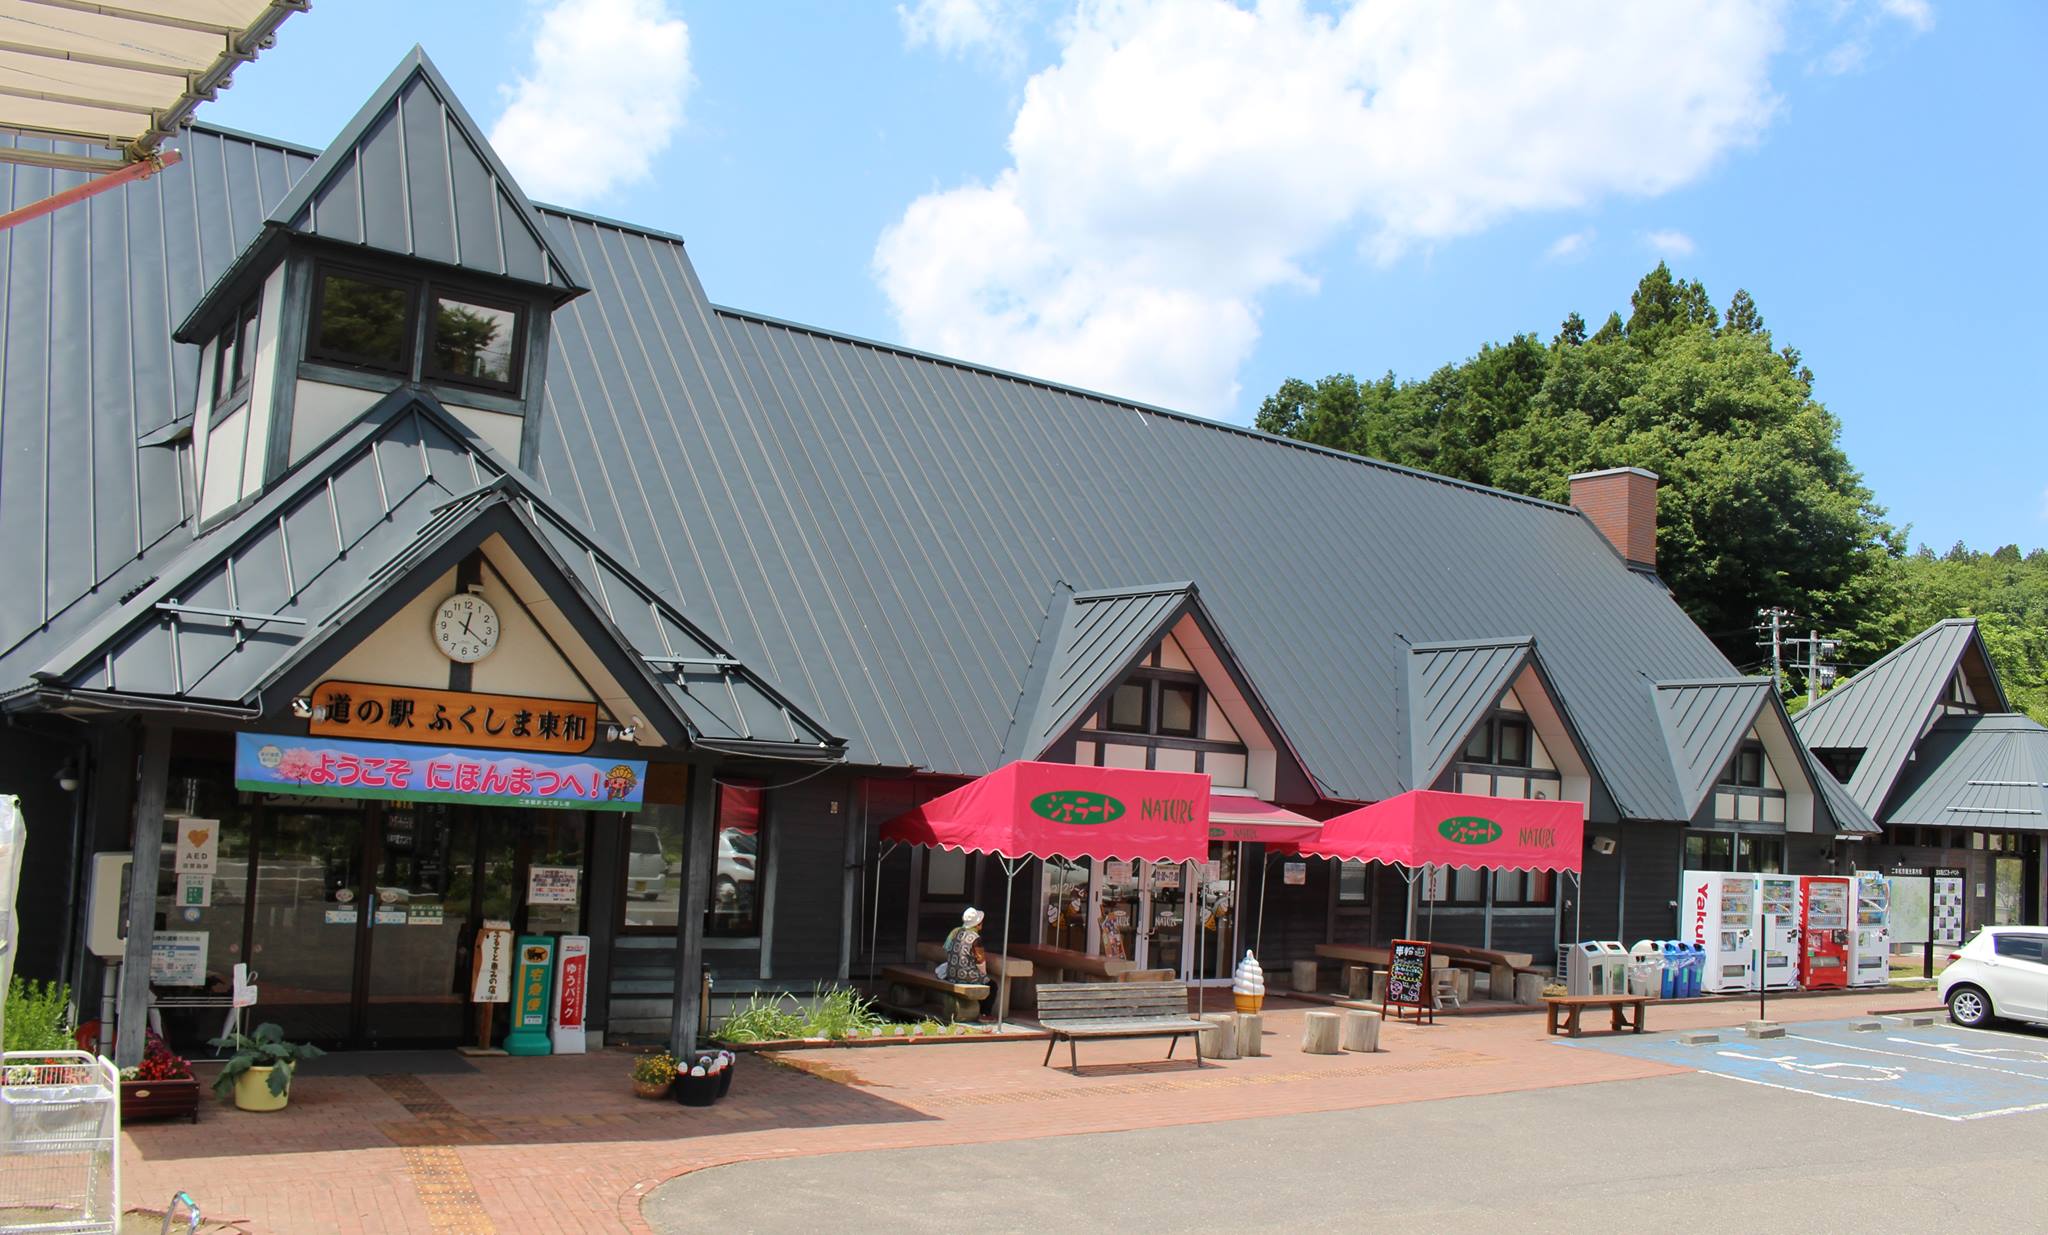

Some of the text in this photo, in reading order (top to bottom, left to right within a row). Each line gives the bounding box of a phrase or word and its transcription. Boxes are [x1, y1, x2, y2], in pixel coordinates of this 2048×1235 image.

[453, 602, 461, 610] 11
[464, 601, 473, 610] 12
[444, 610, 454, 618] 10
[484, 615, 490, 623] 2
[440, 621, 446, 629] 9
[486, 627, 492, 635] 3
[442, 633, 448, 641] 8
[451, 642, 456, 650] 7
[472, 645, 478, 653] 5
[462, 647, 468, 655] 6
[324, 693, 586, 741] 道の駅 ふくしま東和
[308, 752, 412, 788] ようこそ
[1047, 795, 1194, 824] ジェラート NATURE
[1449, 819, 1556, 849] ジェラート NATURE
[186, 852, 208, 860] AED
[1695, 883, 1709, 945] Yakul
[564, 963, 577, 1018] ゆうパック
